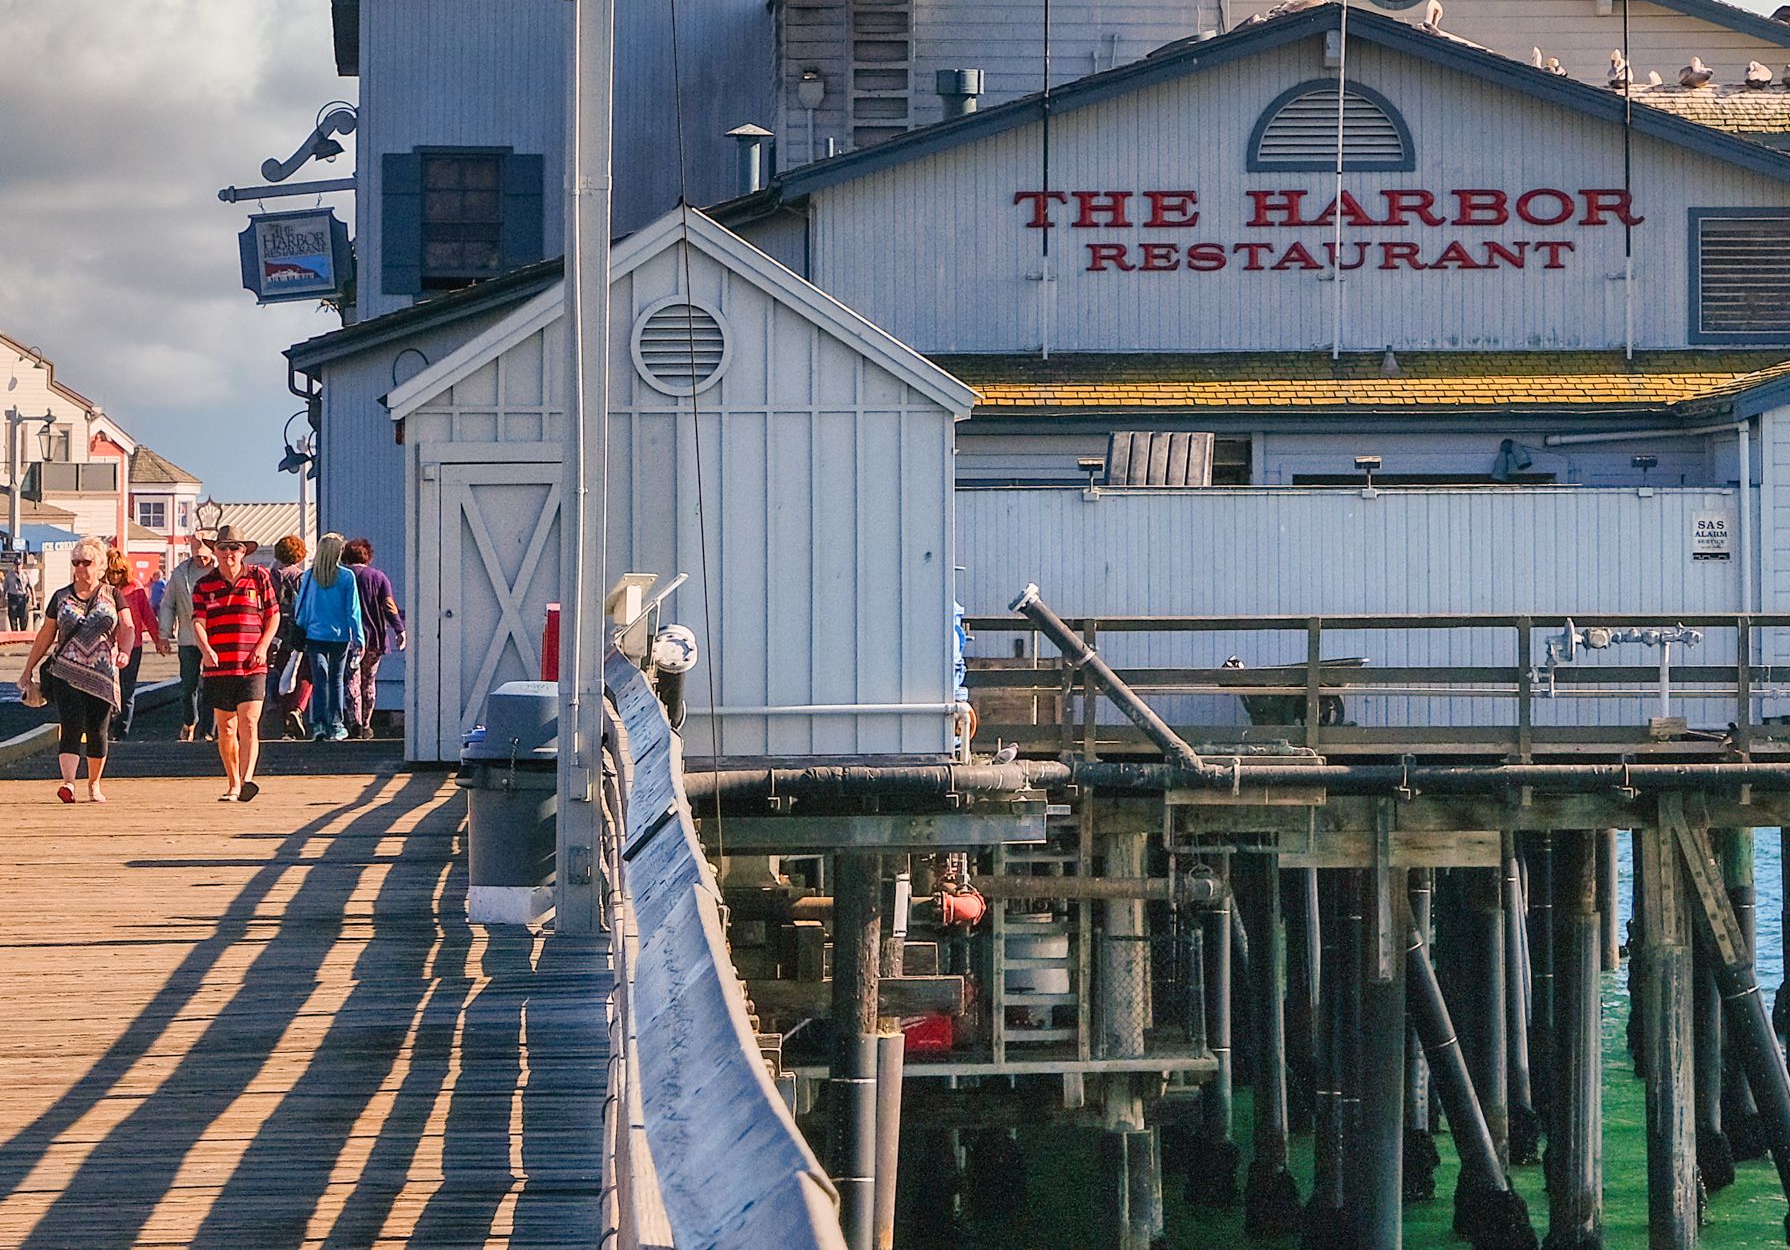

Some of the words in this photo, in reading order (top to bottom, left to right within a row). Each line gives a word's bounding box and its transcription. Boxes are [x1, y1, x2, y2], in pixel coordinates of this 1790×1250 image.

[1013, 191, 1200, 227] THE
[1246, 188, 1645, 227] HARBOR
[263, 231, 326, 249] HARBOR
[1085, 240, 1576, 271] RESTAURANT
[1698, 520, 1725, 530] SAS
